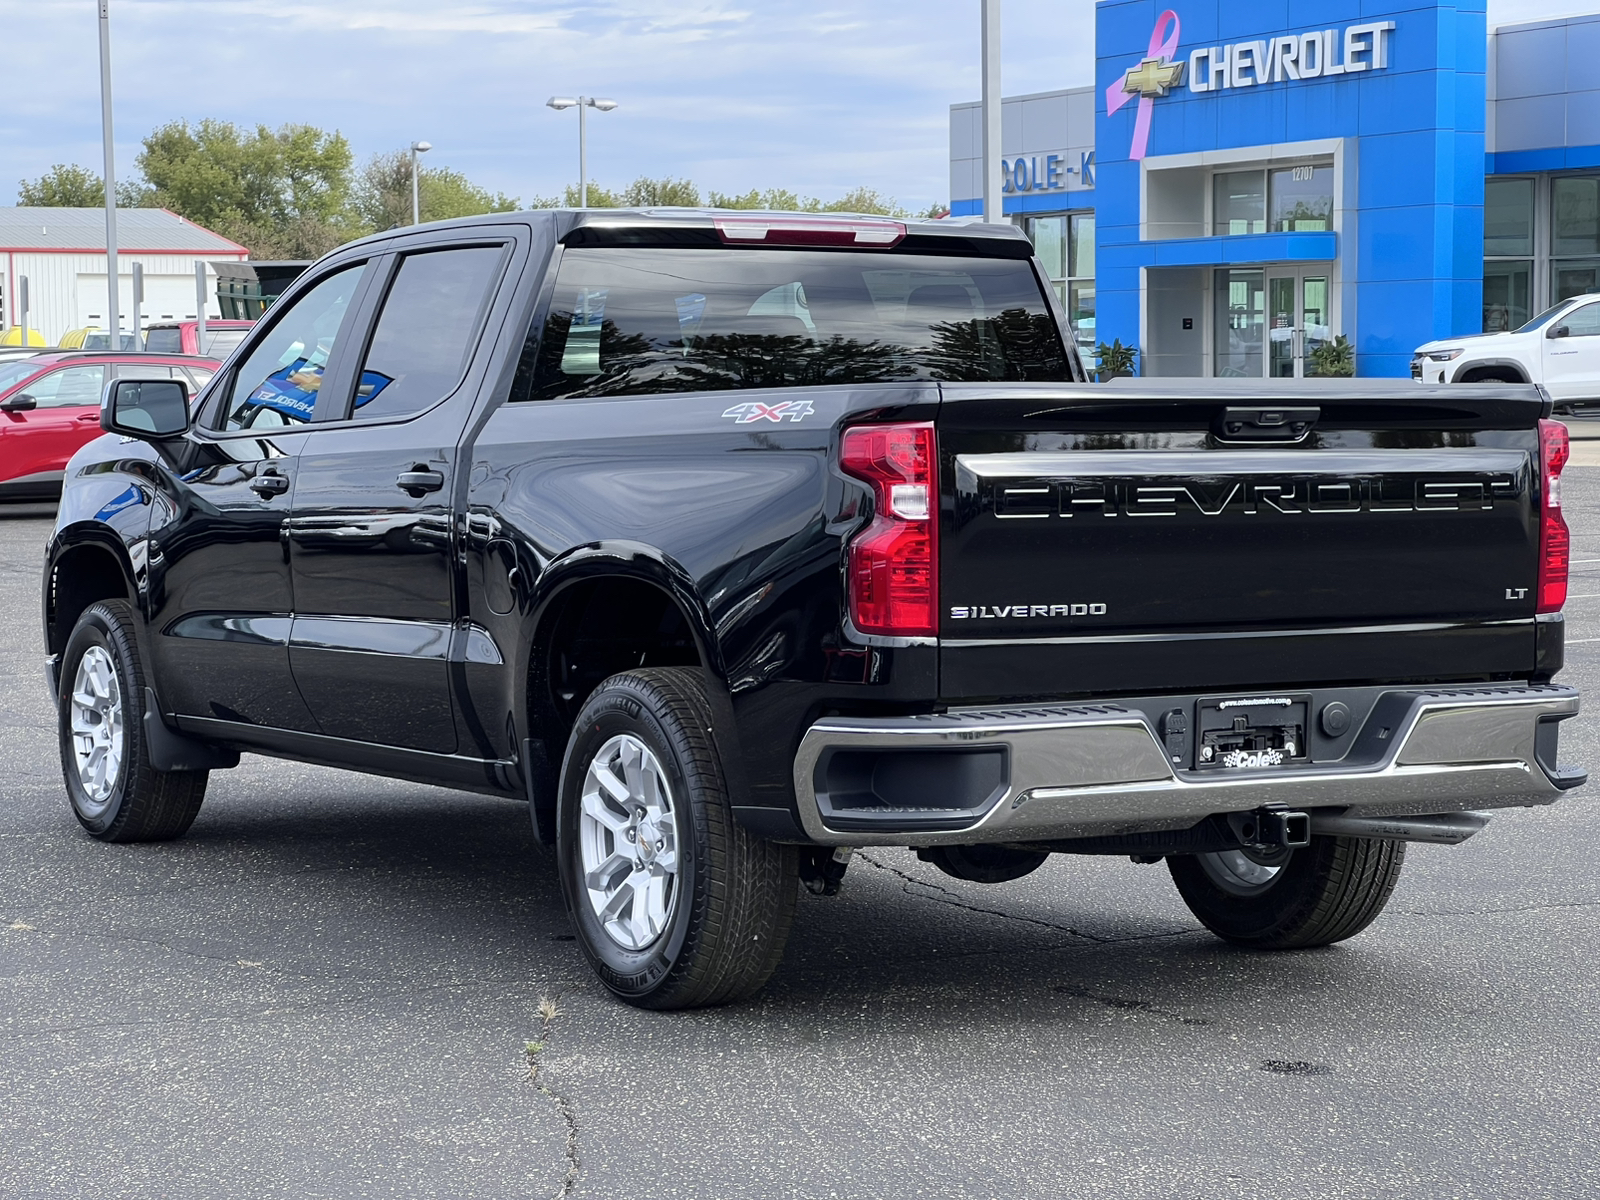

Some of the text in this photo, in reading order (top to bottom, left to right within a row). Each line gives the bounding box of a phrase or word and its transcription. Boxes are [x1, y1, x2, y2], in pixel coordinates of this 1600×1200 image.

[1189, 21, 1393, 93] CHEVROLET
[1292, 165, 1314, 182] 12707
[994, 478, 1511, 518] CHEVROLET
[1505, 587, 1529, 600] LT
[950, 602, 1107, 619] SILVERADO
[593, 697, 640, 719] MICHELIN
[1236, 751, 1270, 768] Cole
